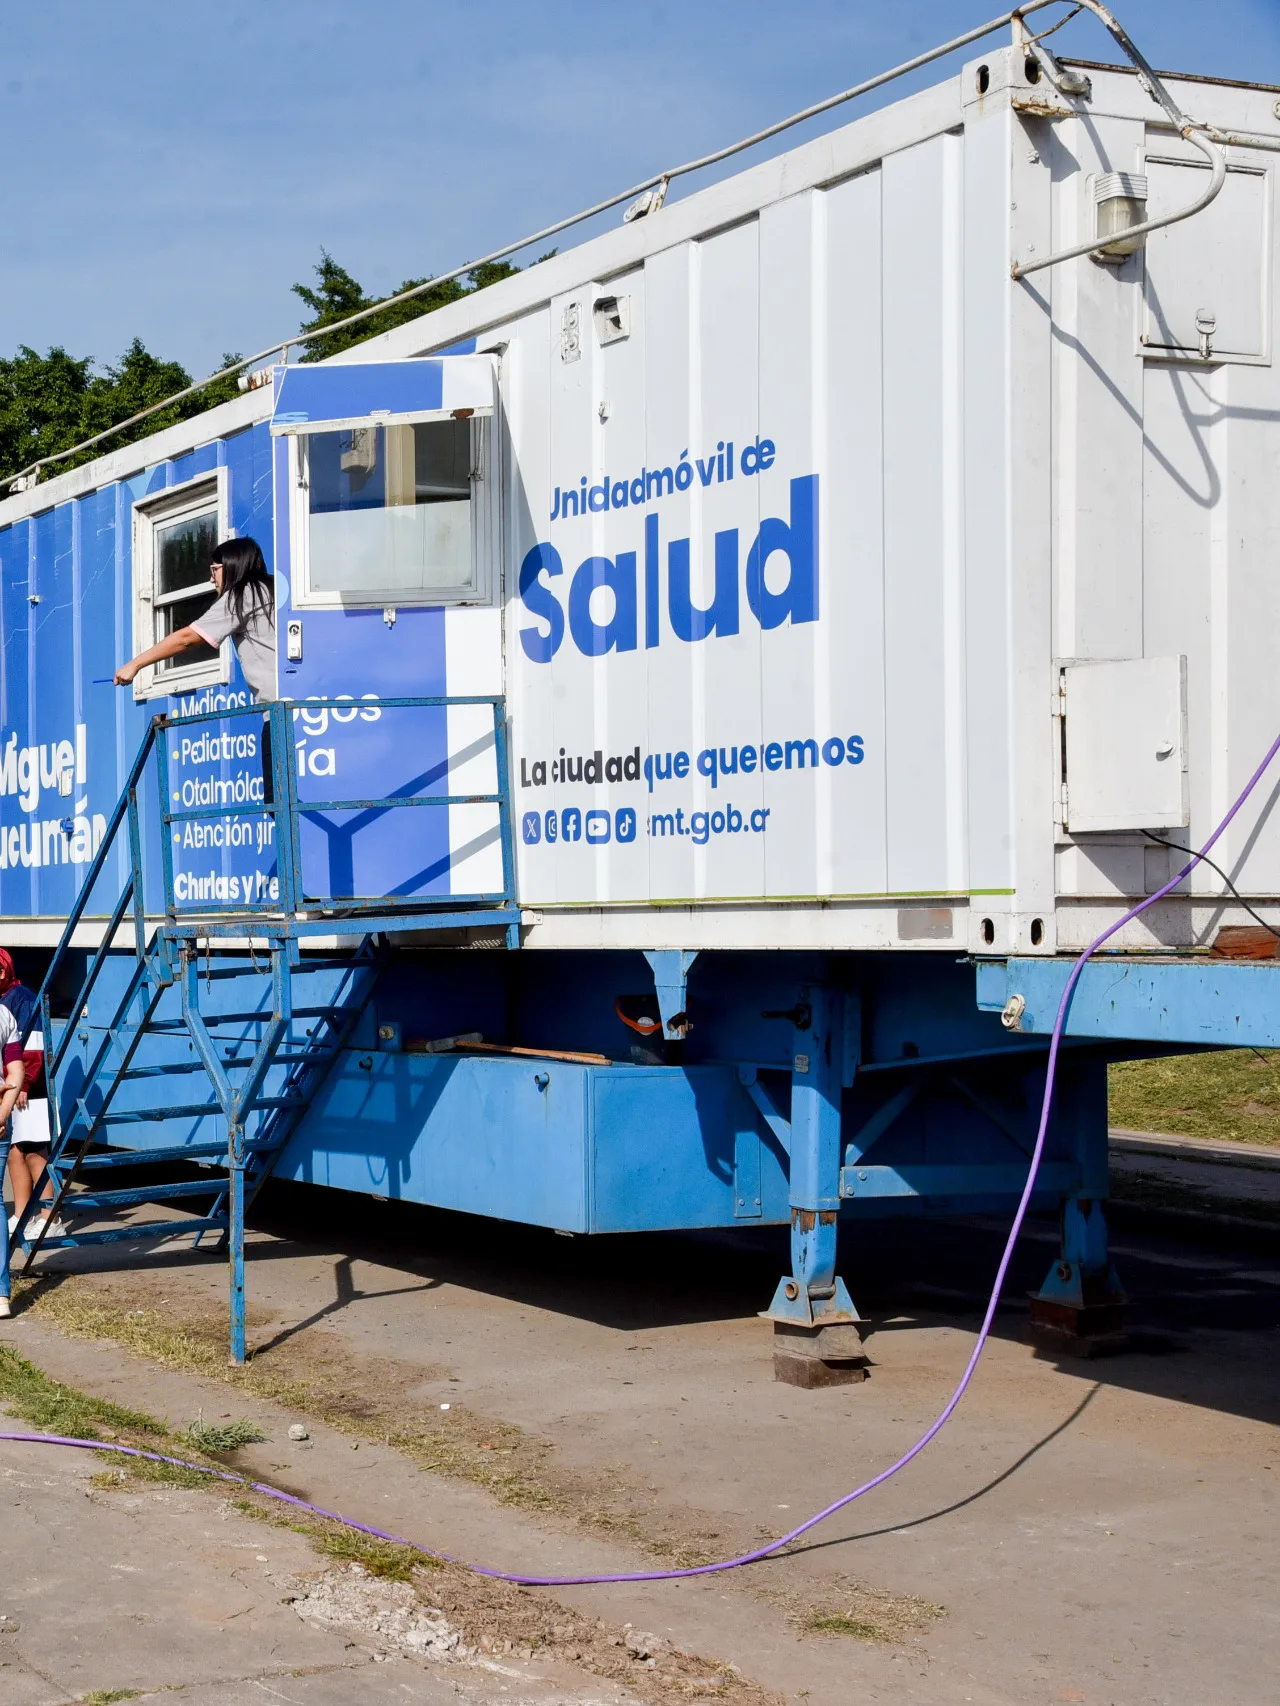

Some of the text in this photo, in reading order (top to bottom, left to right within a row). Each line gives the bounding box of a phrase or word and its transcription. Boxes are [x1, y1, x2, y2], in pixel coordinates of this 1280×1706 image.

[646, 441, 734, 501] móvil
[740, 434, 776, 476] de
[518, 473, 819, 664] Salud
[182, 732, 256, 766] Pediatras
[520, 757, 547, 788] La
[644, 751, 690, 793] que
[183, 815, 252, 849] Atención
[647, 803, 771, 845] mt.gob.ar
[173, 870, 240, 901] Chrlas
